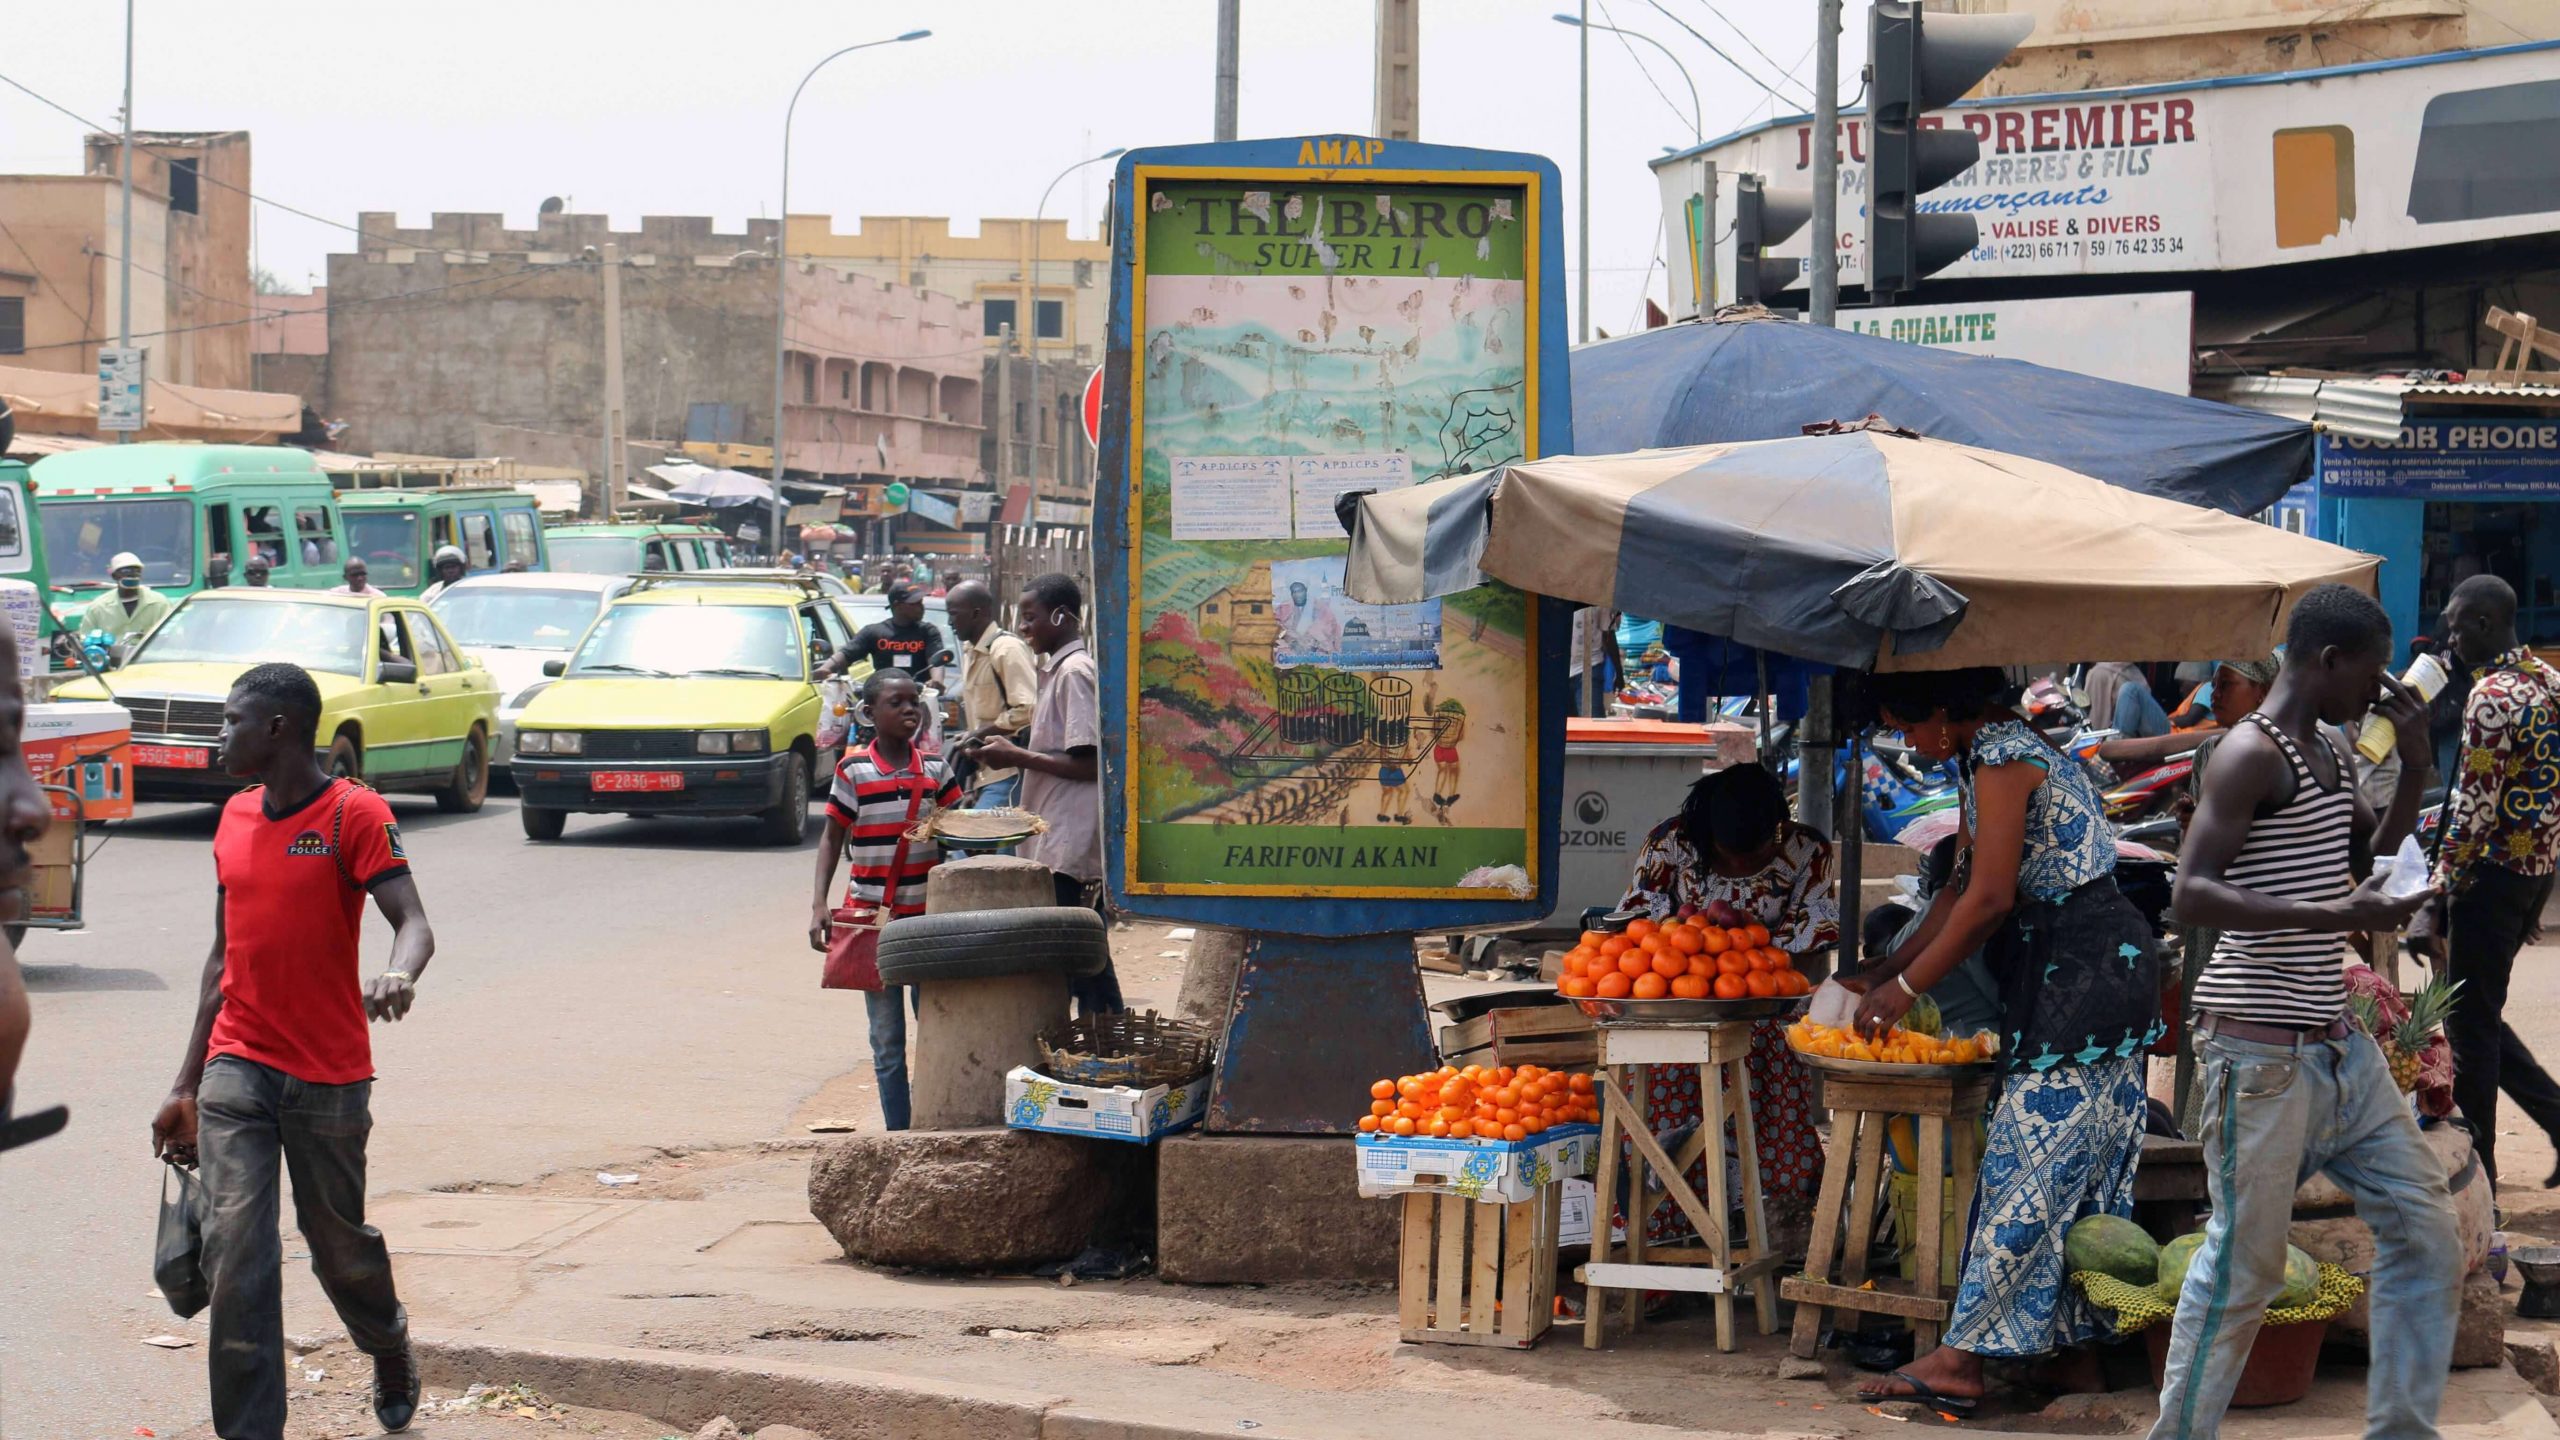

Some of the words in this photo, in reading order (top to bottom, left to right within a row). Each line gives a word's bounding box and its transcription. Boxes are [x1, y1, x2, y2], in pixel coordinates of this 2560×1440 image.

[1962, 98, 2196, 154] PREMIER
[1297, 139, 1385, 165] AMAP
[1985, 153, 2071, 187] FRERES
[2078, 151, 2094, 179] &
[2102, 148, 2153, 178] FILS
[1330, 199, 1493, 239] BARO
[1991, 219, 2059, 240] VALISE
[2066, 218, 2080, 236] &
[2087, 214, 2161, 235] DIVERS
[1254, 242, 1374, 269] SUPER
[1388, 244, 1422, 269] 11
[1971, 245, 1998, 262] Cell:
[1999, 243, 2037, 264] (+223)
[2039, 242, 2054, 259] 66
[2056, 242, 2069, 258] 71
[2090, 240, 2105, 257] 59
[2115, 239, 2130, 255] 76
[2133, 238, 2148, 254] 42
[2151, 237, 2166, 254] 35
[2169, 237, 2184, 253] 34
[1891, 313, 1996, 345] QUALITE
[2449, 426, 2558, 449] PHONE
[2323, 457, 2341, 467] Vente
[877, 638, 926, 653] Orange
[290, 846, 328, 854] POLICE
[1558, 830, 1627, 846] OZONE
[1223, 845, 1345, 868] FARIFONI
[1351, 846, 1439, 868] AKANI
